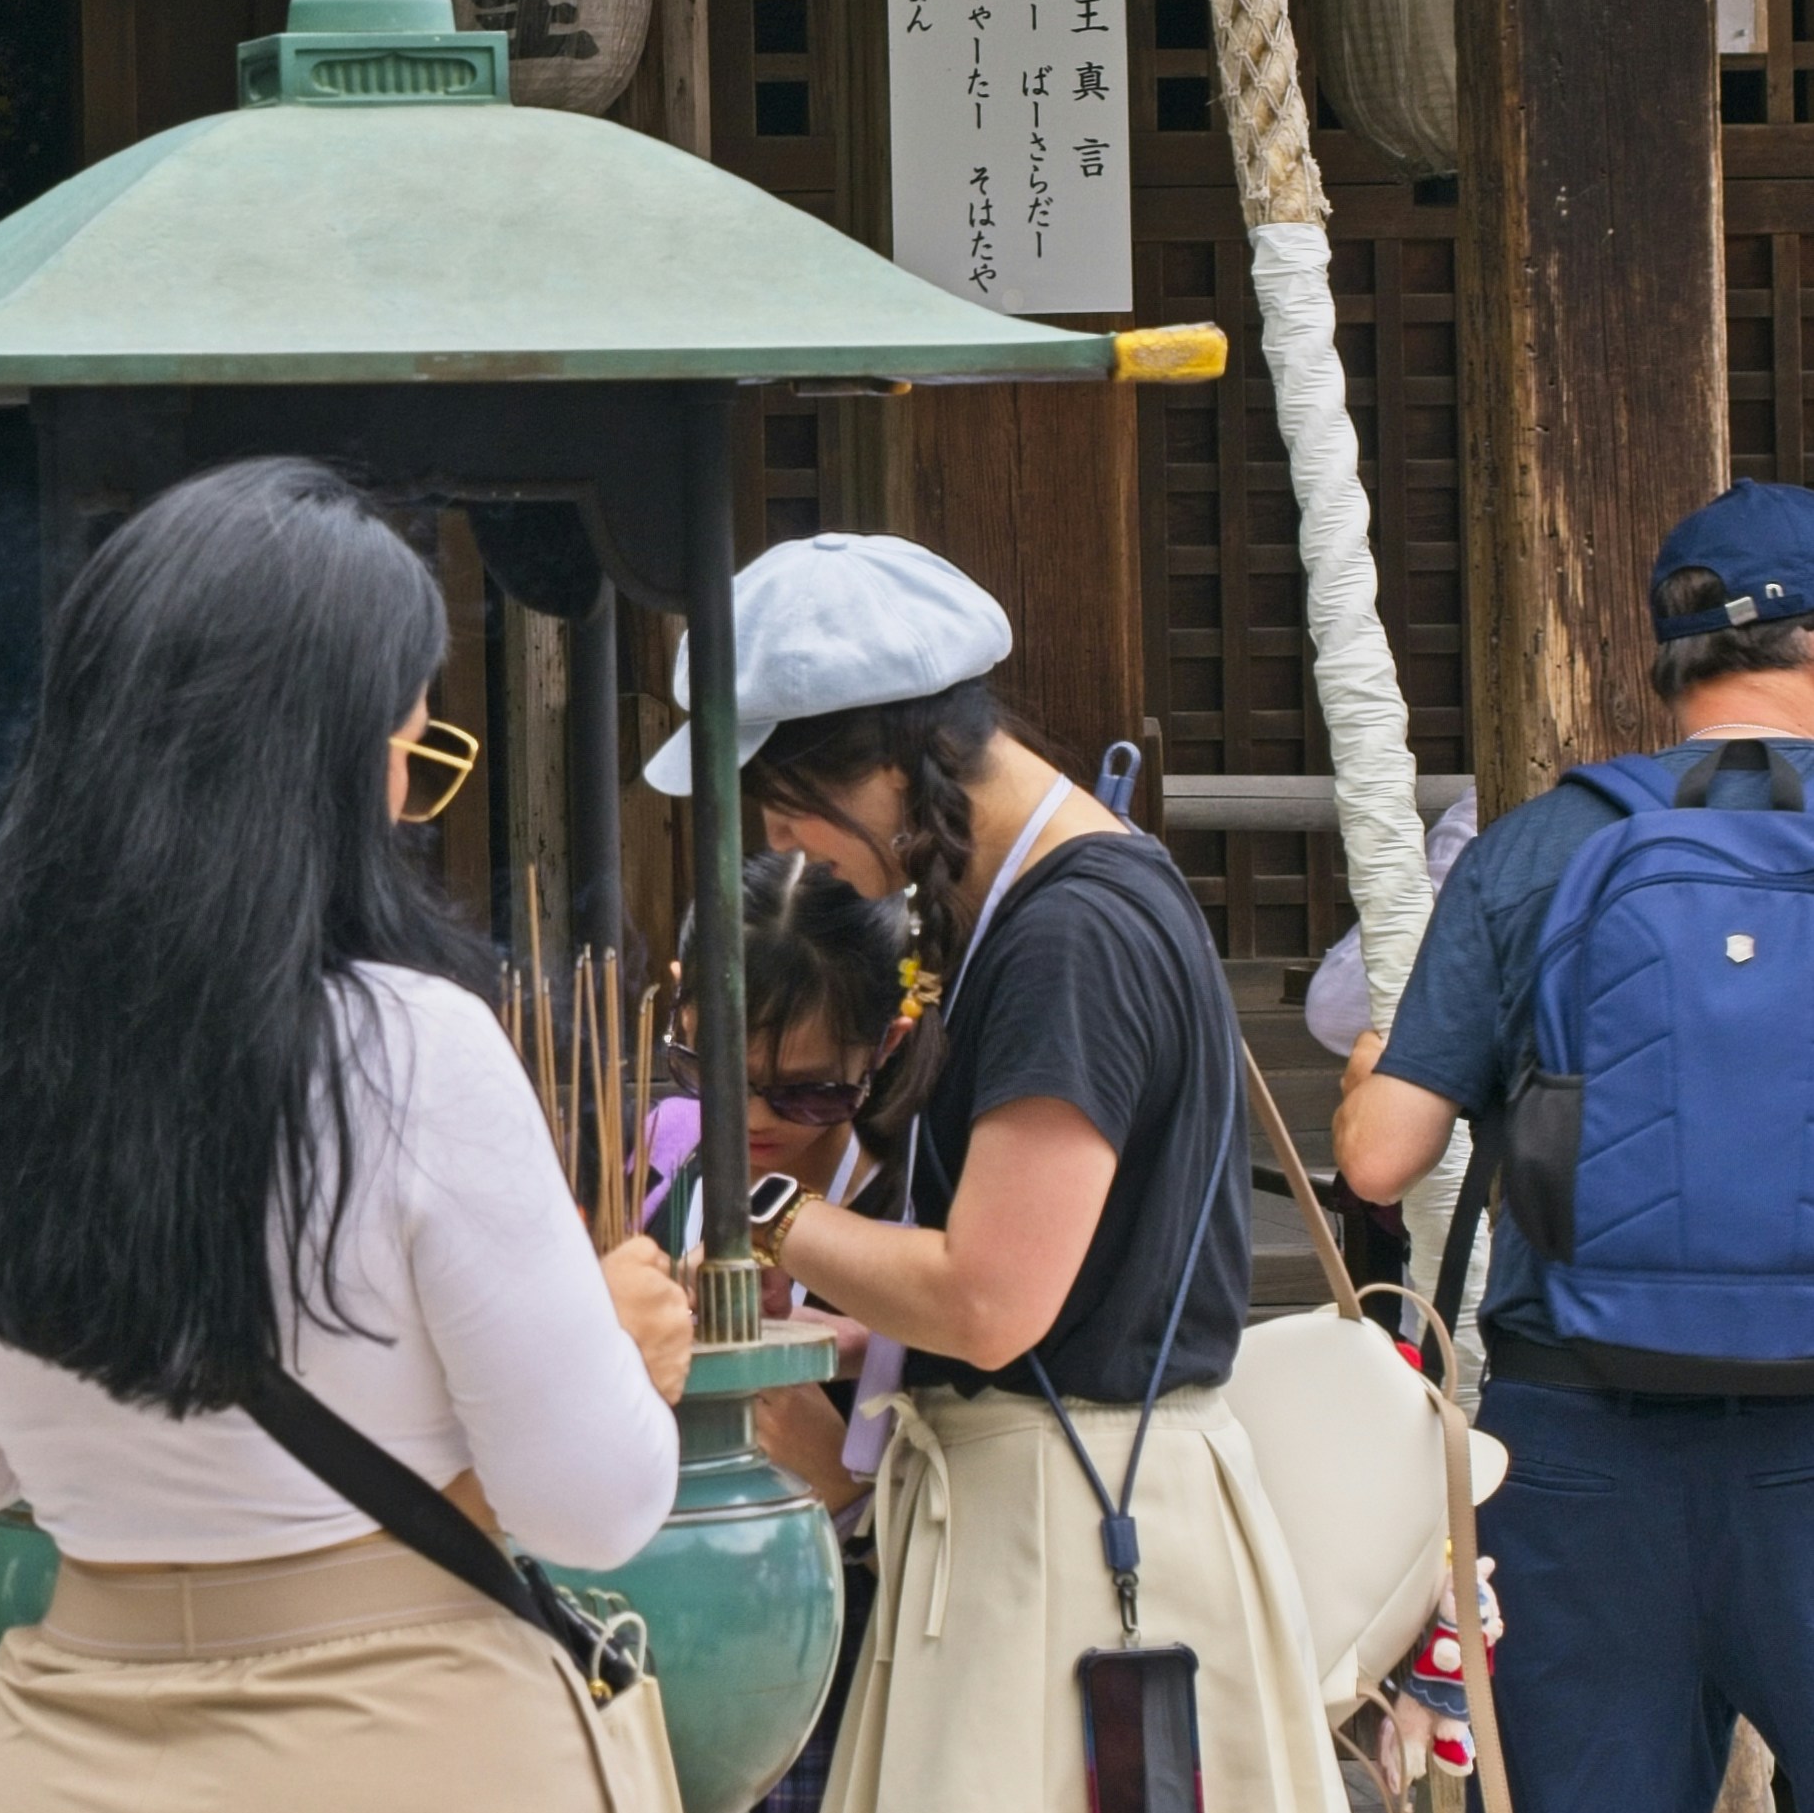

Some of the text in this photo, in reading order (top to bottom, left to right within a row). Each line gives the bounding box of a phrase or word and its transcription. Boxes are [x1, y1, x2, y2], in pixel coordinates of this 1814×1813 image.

[968, 166, 997, 294] そはたや
[1021, 65, 1054, 259] ばーさらだー
